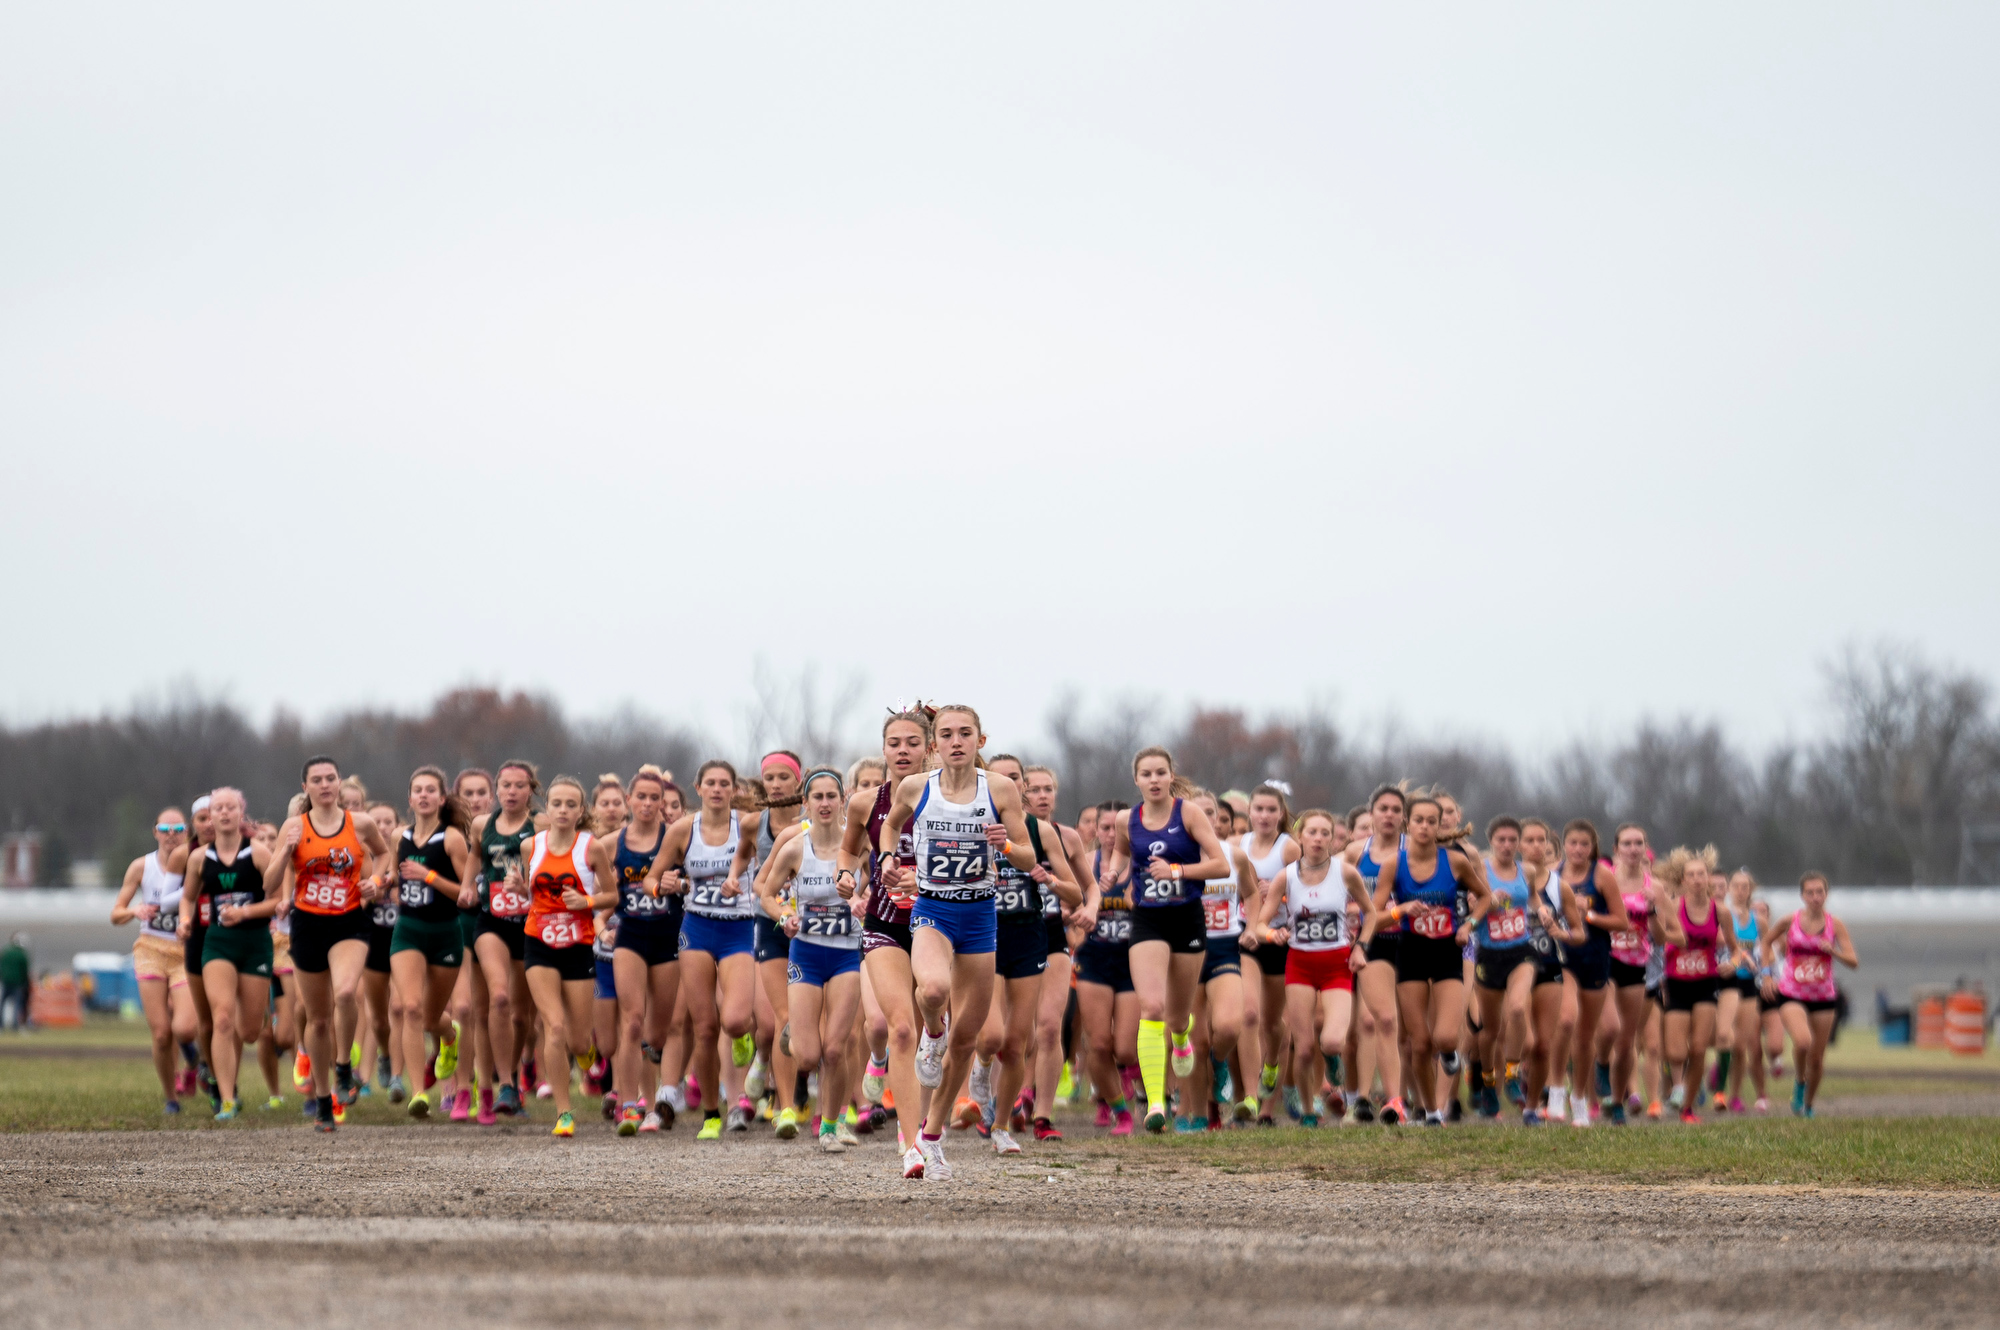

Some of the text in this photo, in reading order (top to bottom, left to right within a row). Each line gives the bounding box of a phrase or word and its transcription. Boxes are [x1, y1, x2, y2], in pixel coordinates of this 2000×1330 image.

[926, 820, 952, 831] WEST
[690, 860, 708, 868] WEST
[931, 855, 984, 877] 274
[803, 876, 822, 885] WEST
[1144, 878, 1181, 897] 201
[305, 882, 346, 906] 585
[401, 883, 428, 905] 351
[626, 893, 666, 911] 340
[931, 889, 972, 900] NIKE
[995, 889, 1027, 910] 291
[542, 922, 578, 943] 621
[807, 918, 846, 936] 271
[1097, 920, 1130, 938] 312
[1296, 921, 1337, 940] 286
[1414, 914, 1446, 934] 617
[1489, 915, 1524, 939] 588
[1794, 963, 1824, 983] 624
